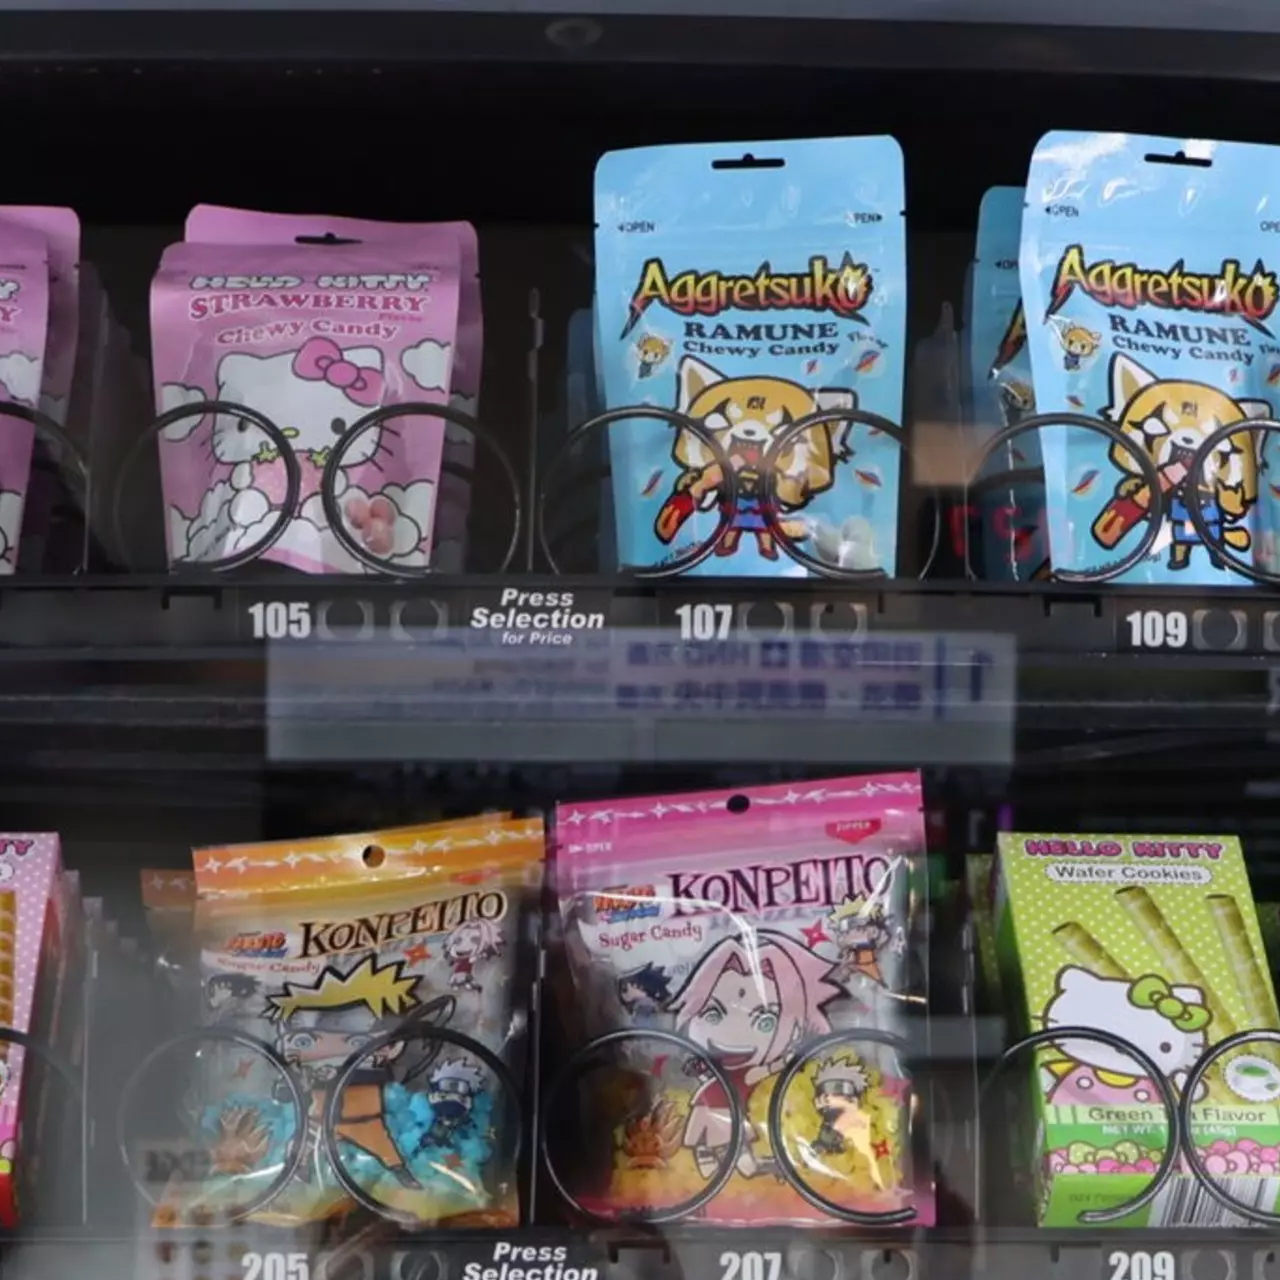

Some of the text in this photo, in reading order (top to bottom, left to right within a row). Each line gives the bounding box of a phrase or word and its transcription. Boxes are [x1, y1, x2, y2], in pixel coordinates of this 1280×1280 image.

[189, 293, 430, 320] STRAWBERRY
[621, 252, 874, 341] Aggretsuko
[217, 319, 398, 346] Chewy Candy
[683, 321, 839, 341] RAMUNE
[1108, 314, 1251, 348] RAMUNE
[683, 340, 840, 358] Chewy Candy
[1111, 335, 1255, 367] Chewy Candy
[500, 587, 575, 608] Press
[248, 602, 311, 640] 105
[470, 606, 606, 634] Selection
[675, 604, 733, 641] 107
[1126, 610, 1188, 648] 109
[501, 630, 573, 646] for Price
[1025, 839, 1223, 860] HELLO KITTY
[665, 853, 895, 917] KONPEITO
[1053, 865, 1203, 882] Wafer Cookies
[298, 890, 507, 960] KONPEITO
[598, 921, 704, 951] Sugar Candy
[1088, 1106, 1154, 1123] Green
[1203, 1106, 1268, 1123] Flavor
[491, 1242, 568, 1262] Press
